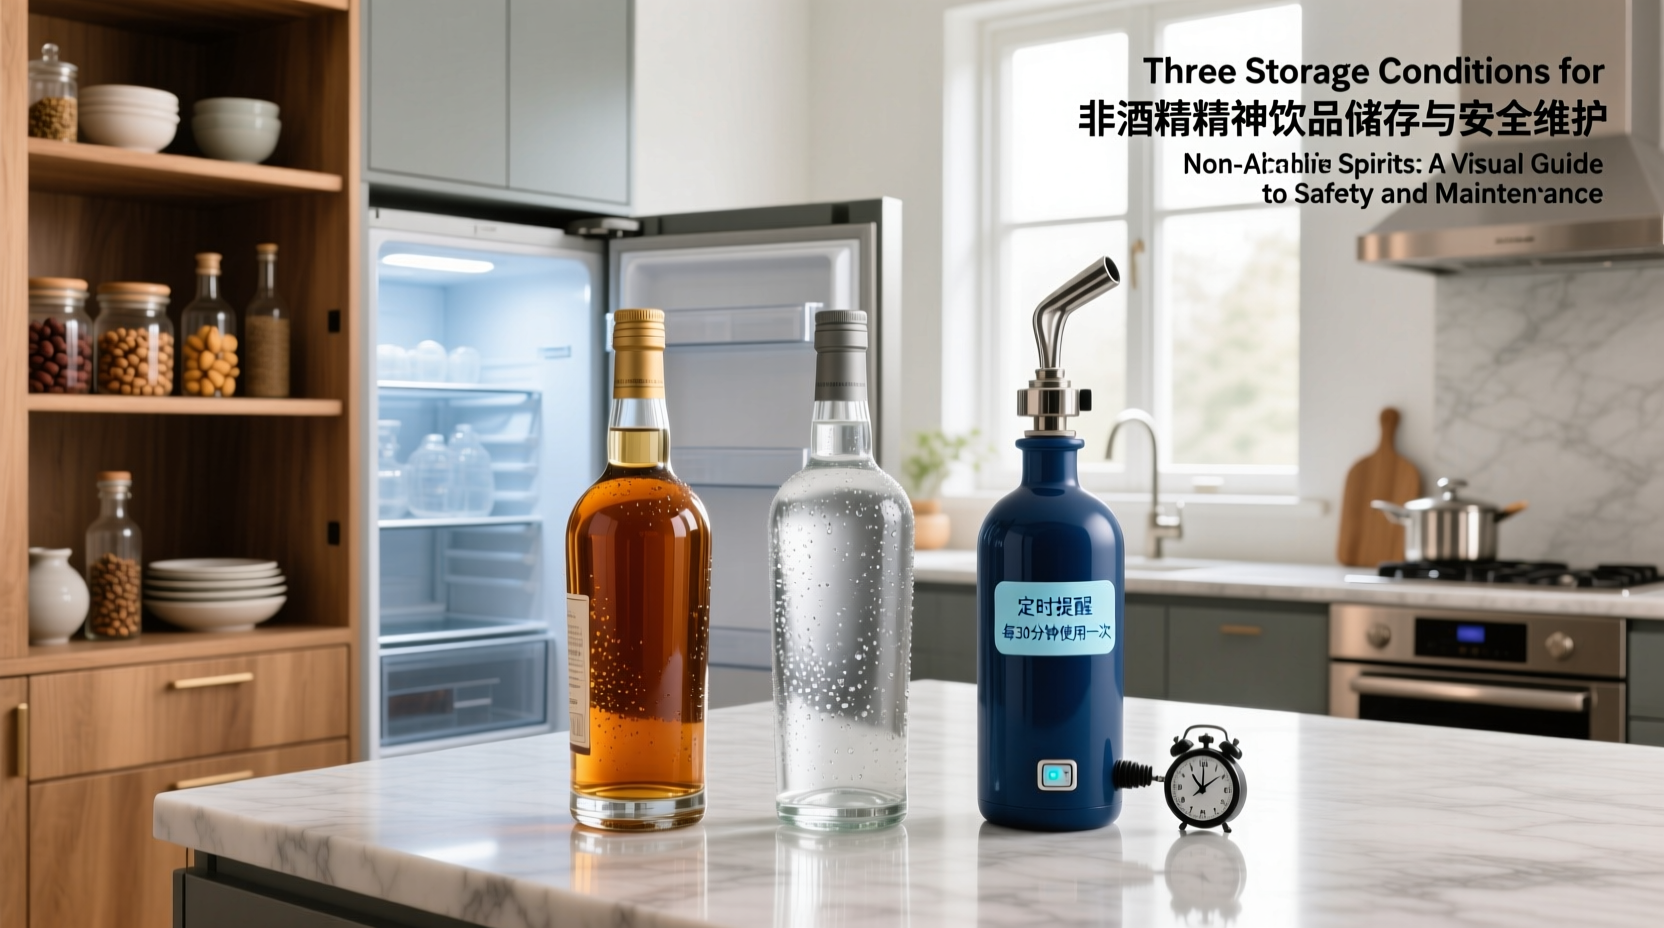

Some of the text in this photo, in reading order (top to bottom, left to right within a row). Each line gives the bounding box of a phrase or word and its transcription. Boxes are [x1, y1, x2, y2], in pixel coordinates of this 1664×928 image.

[1018, 596, 1093, 616] 定时提醒
[1002, 623, 1111, 641] 每30分钟使用一次
